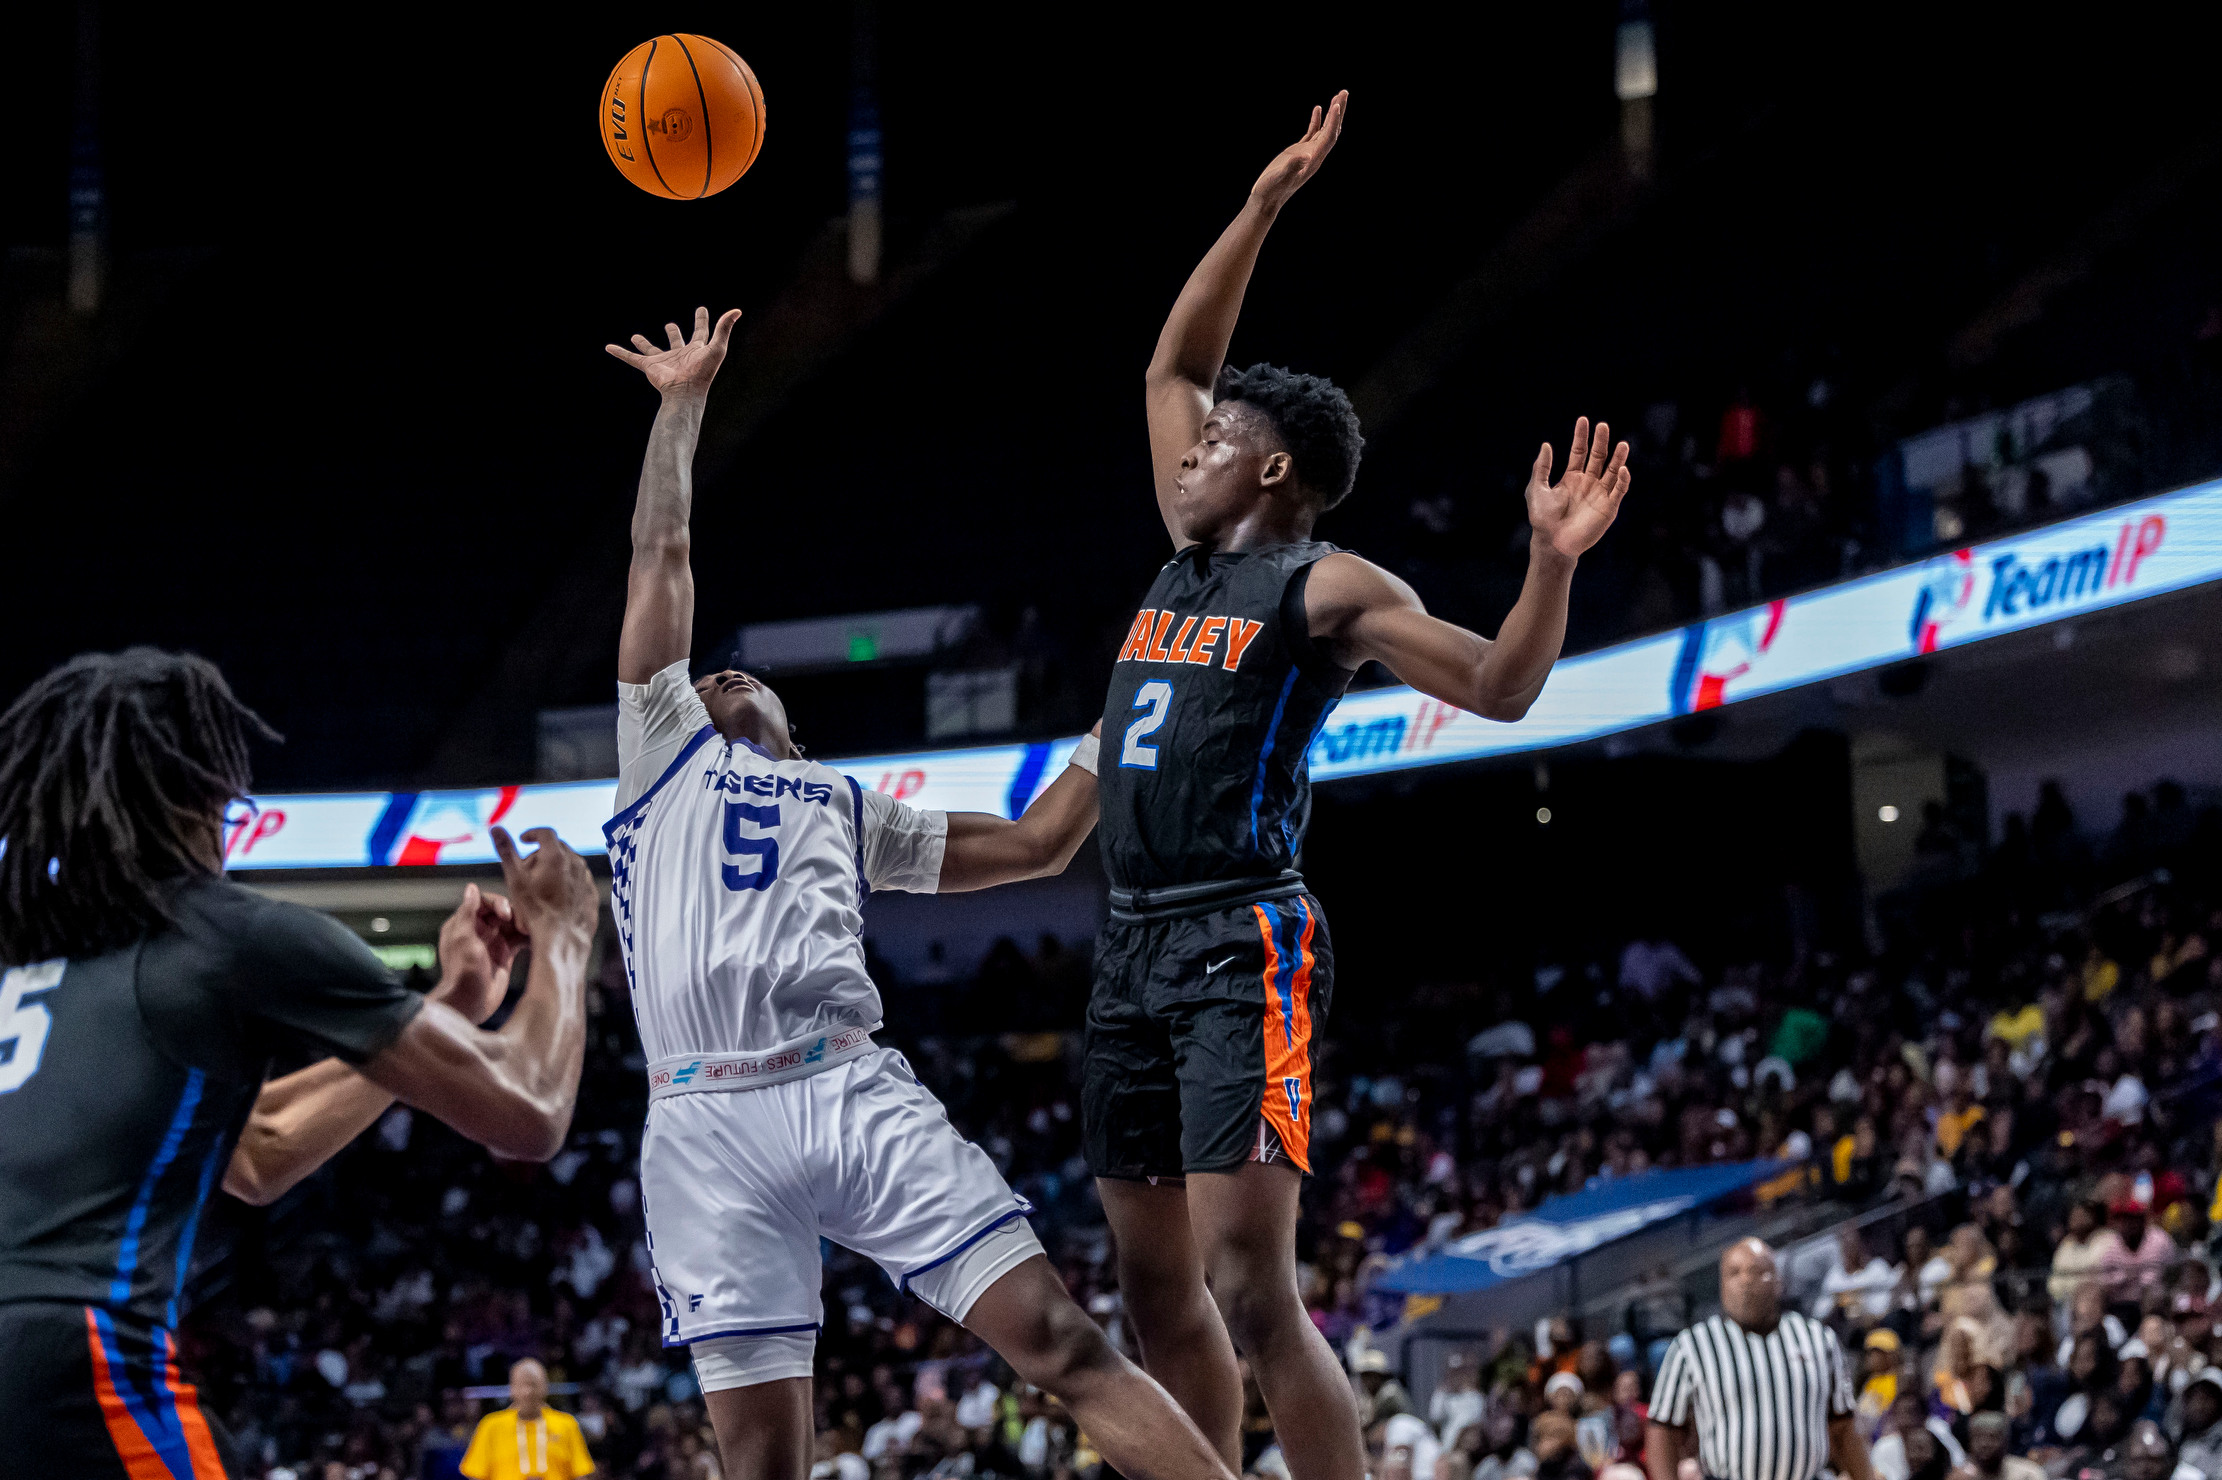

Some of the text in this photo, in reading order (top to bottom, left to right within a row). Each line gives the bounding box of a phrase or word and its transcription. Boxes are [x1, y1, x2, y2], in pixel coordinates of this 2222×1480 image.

[612, 97, 635, 162] EVO
[1118, 678, 1175, 771] 2
[721, 797, 781, 892] 5
[0, 957, 68, 1095] 5
[831, 1029, 869, 1051] FUTURE
[705, 1060, 759, 1079] FUTURE
[767, 1052, 801, 1071] ONES
[1282, 1076, 1301, 1122] V
